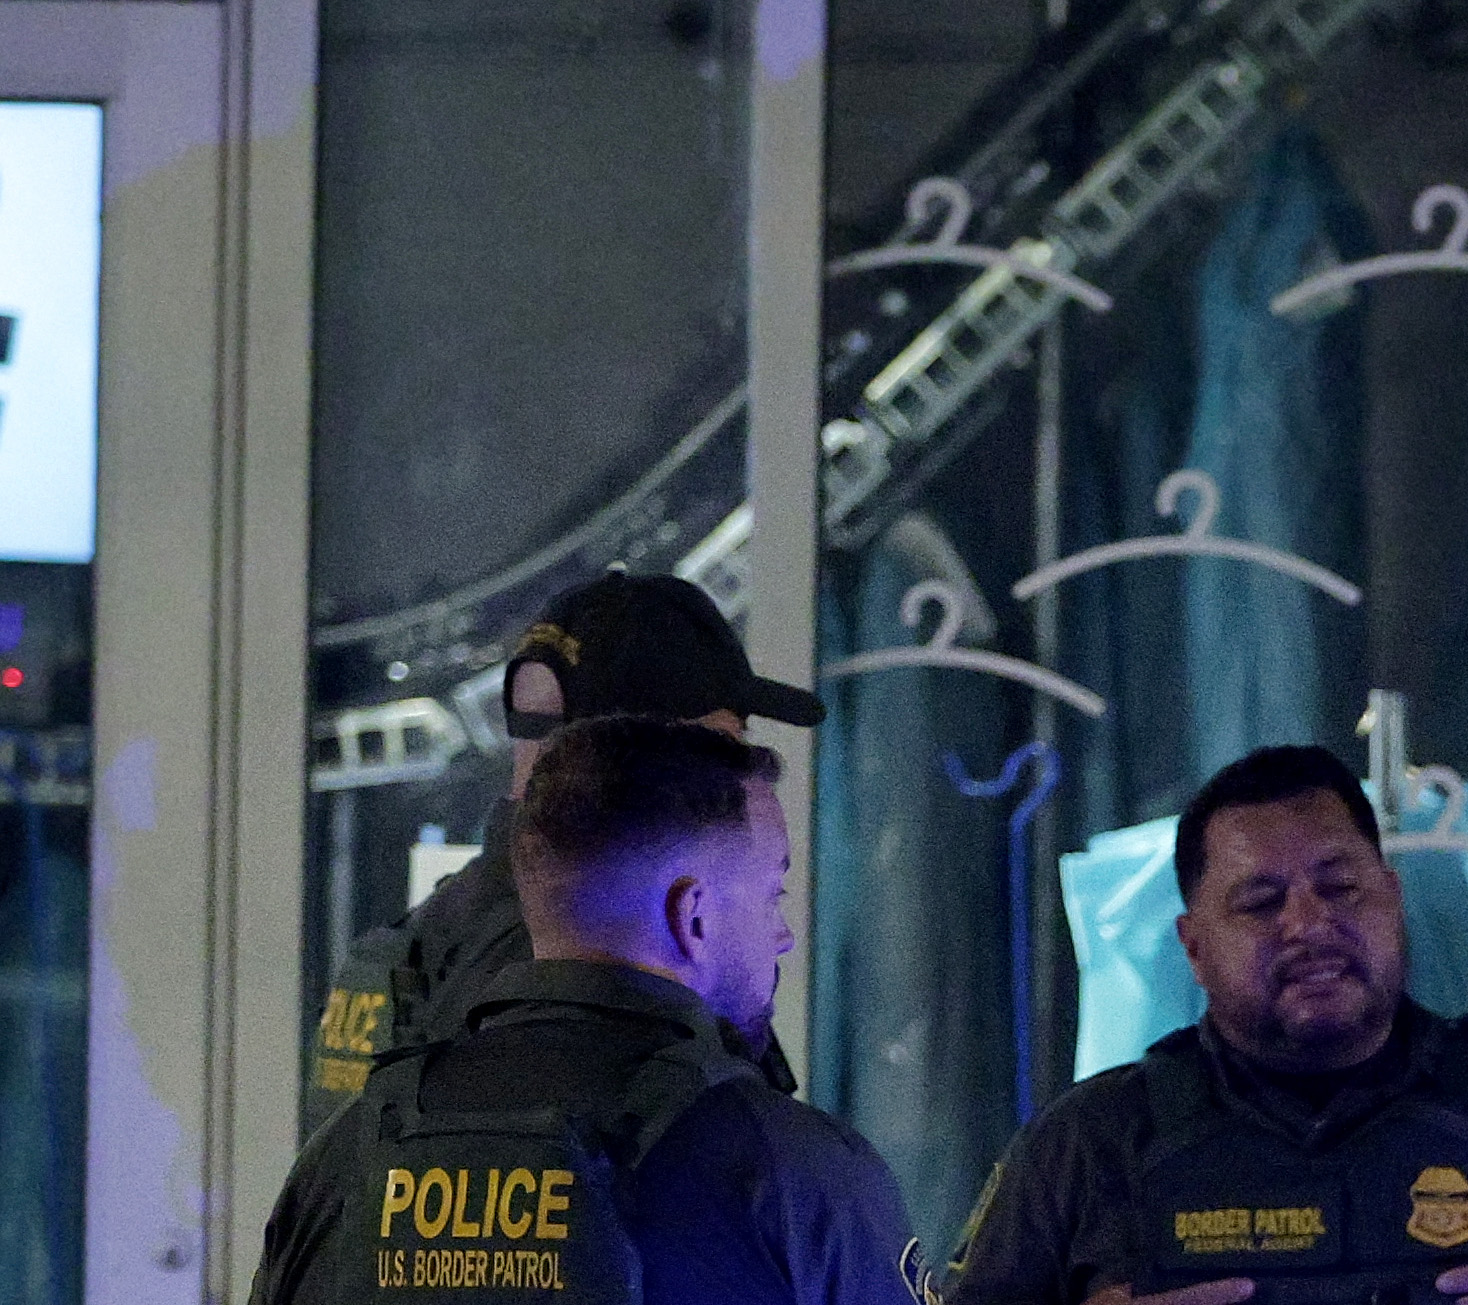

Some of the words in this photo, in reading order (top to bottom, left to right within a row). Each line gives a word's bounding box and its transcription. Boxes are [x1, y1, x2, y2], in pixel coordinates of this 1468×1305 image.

[380, 1167, 574, 1239] POLICE
[1174, 1208, 1250, 1240] BORDER
[1255, 1207, 1327, 1236] PATROL
[378, 1250, 407, 1289] U.S.
[413, 1250, 488, 1288] BORDER
[492, 1250, 565, 1290] PATROL
